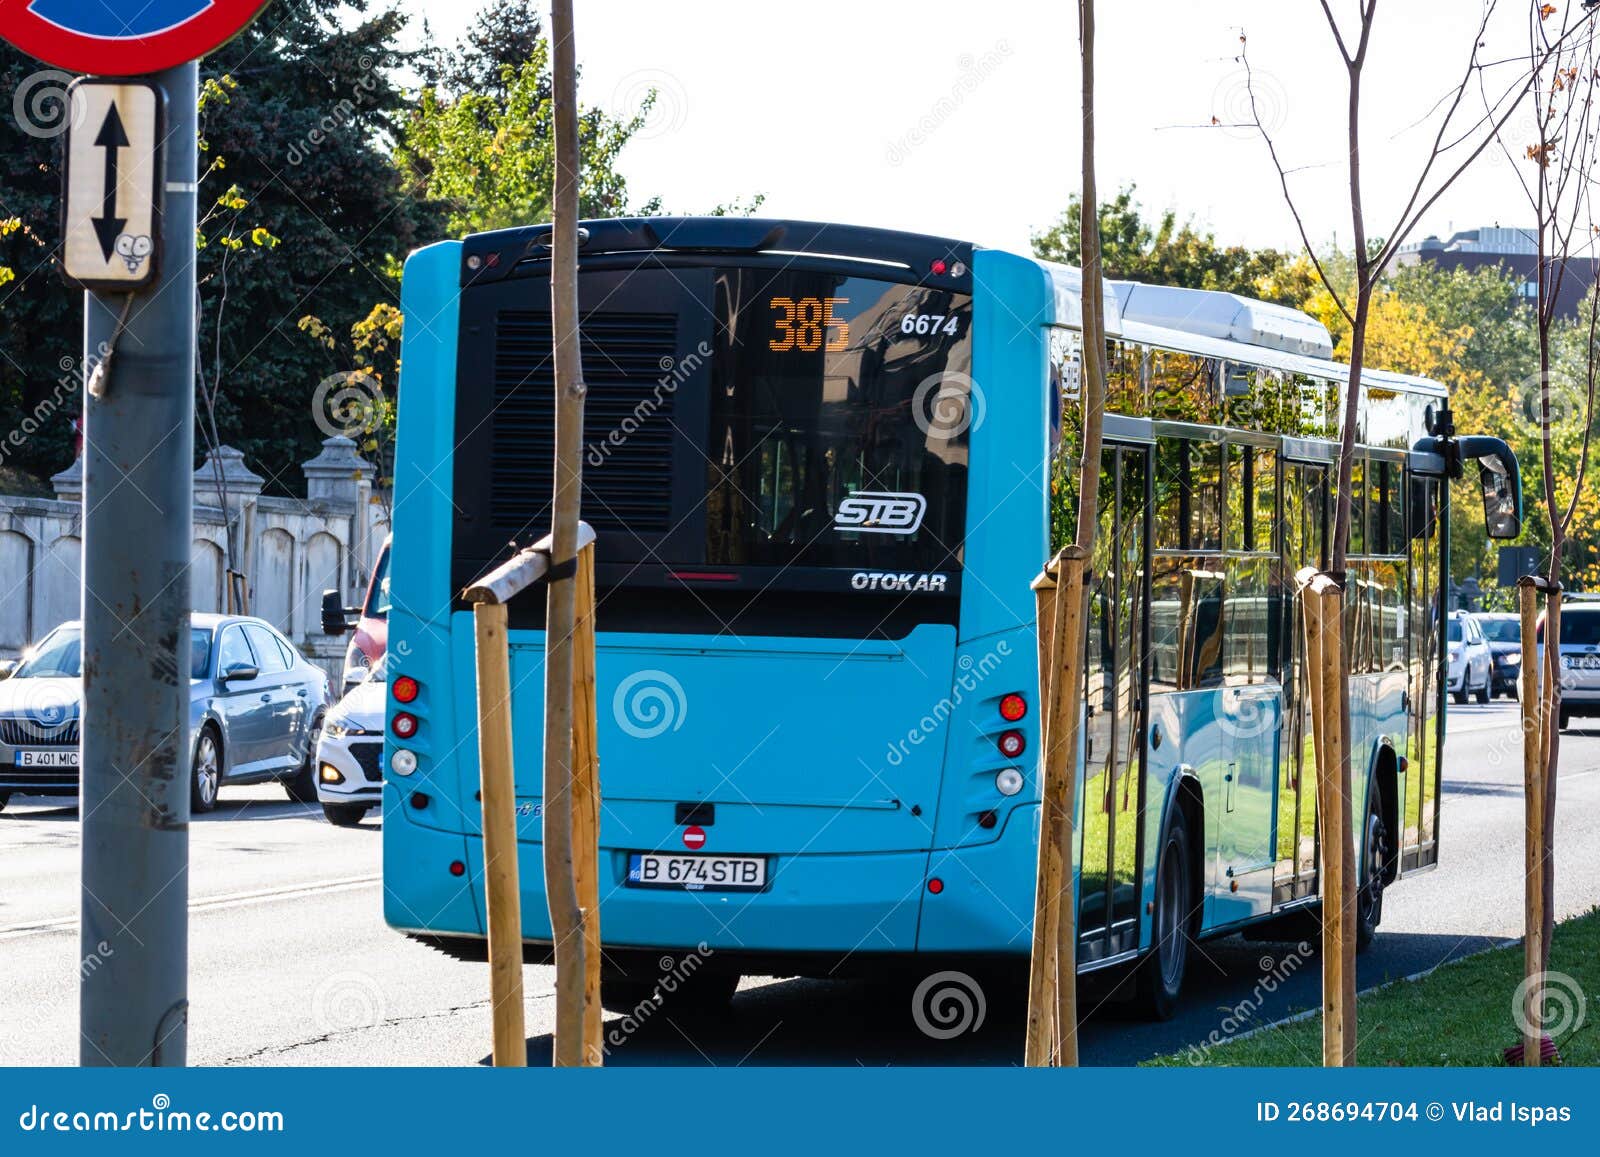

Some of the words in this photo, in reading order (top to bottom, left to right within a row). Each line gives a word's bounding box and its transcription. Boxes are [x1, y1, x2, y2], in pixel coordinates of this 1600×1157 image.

[769, 297, 849, 351] 385
[901, 313, 957, 335] 6674
[834, 498, 918, 526] STB
[851, 572, 947, 592] OTOKAR
[24, 753, 33, 765] B
[37, 753, 55, 765] 401
[643, 858, 660, 880] B
